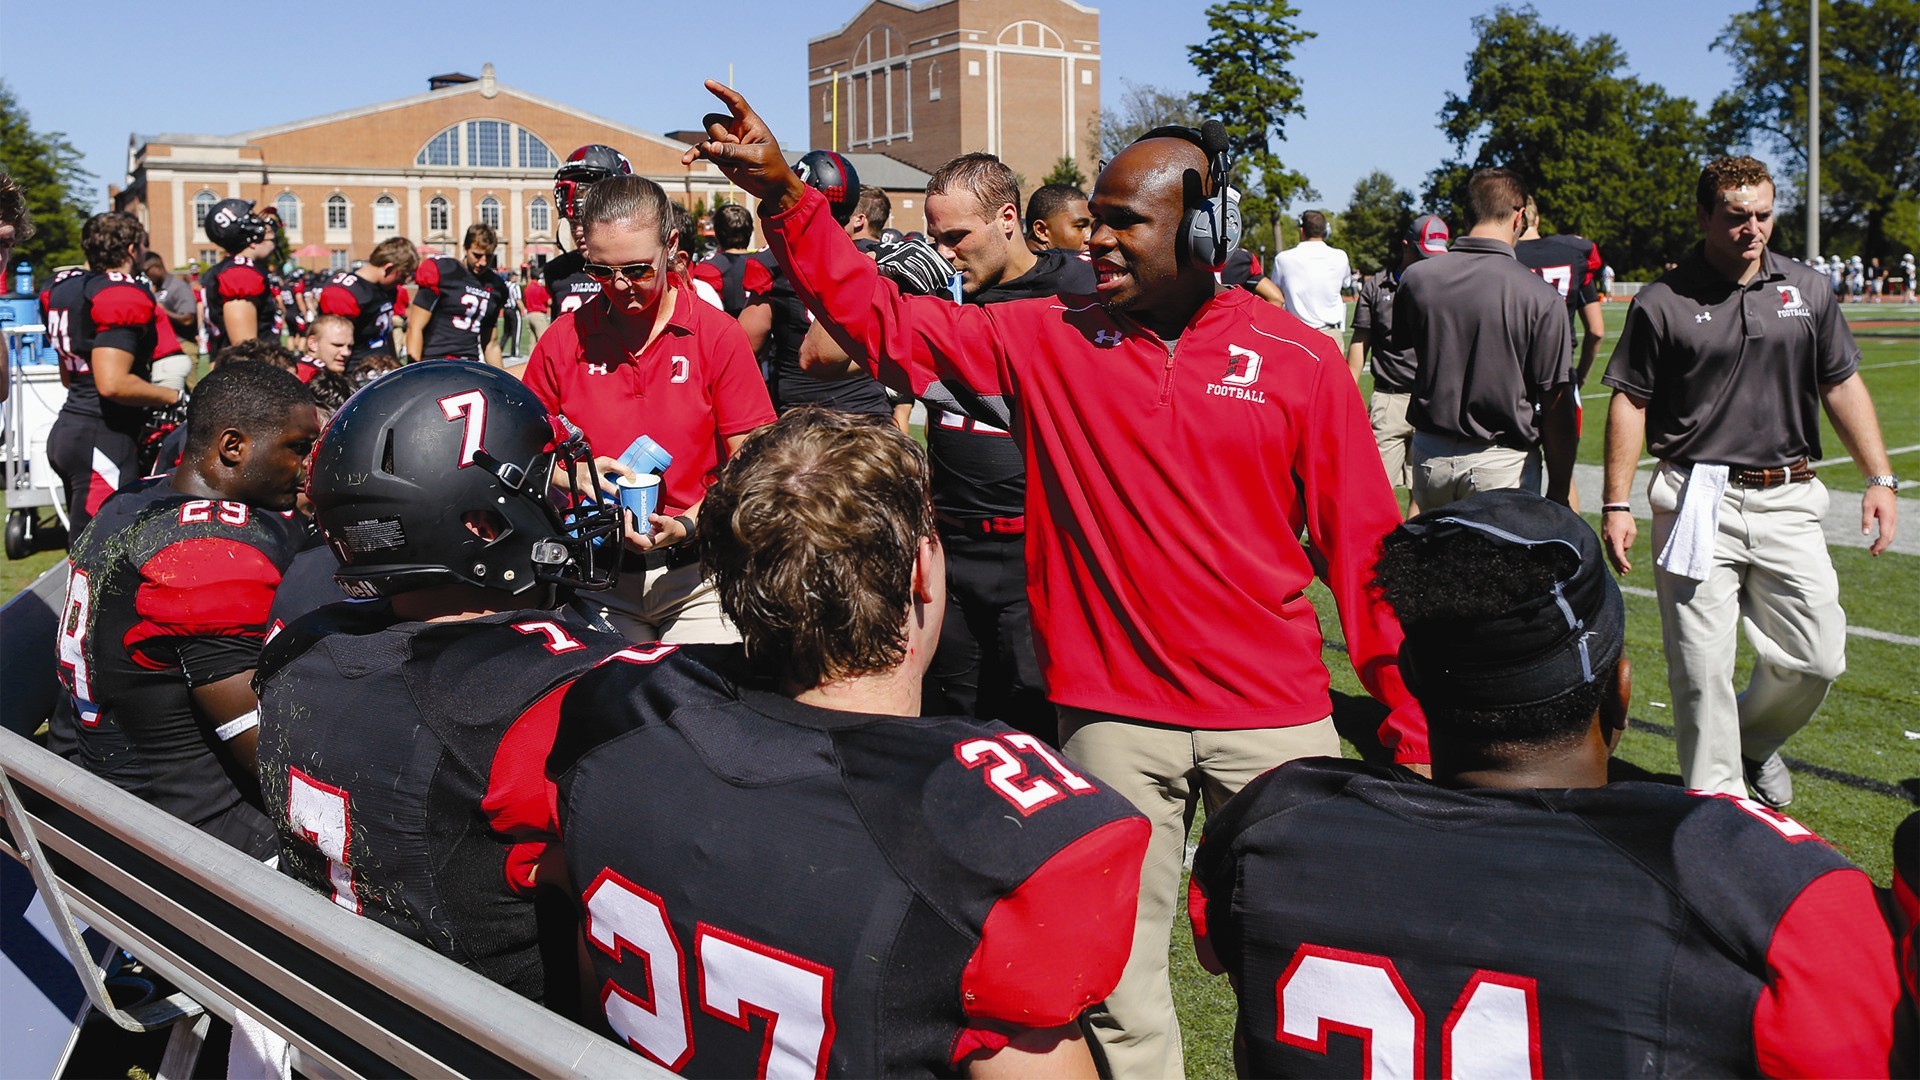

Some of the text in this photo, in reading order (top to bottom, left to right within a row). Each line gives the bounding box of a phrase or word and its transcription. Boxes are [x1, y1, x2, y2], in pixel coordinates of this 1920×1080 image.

[214, 207, 238, 228] 91
[332, 272, 358, 287] 36
[1777, 309, 1811, 319] FOOTBALL
[670, 355, 691, 384] D
[1220, 343, 1264, 388] D
[1205, 383, 1266, 404] FOOTBALL
[436, 388, 489, 469] 7
[178, 499, 250, 527] 29
[510, 620, 588, 656] 7
[952, 732, 1098, 818] 27
[288, 764, 364, 918] 7
[581, 865, 836, 1080] 27
